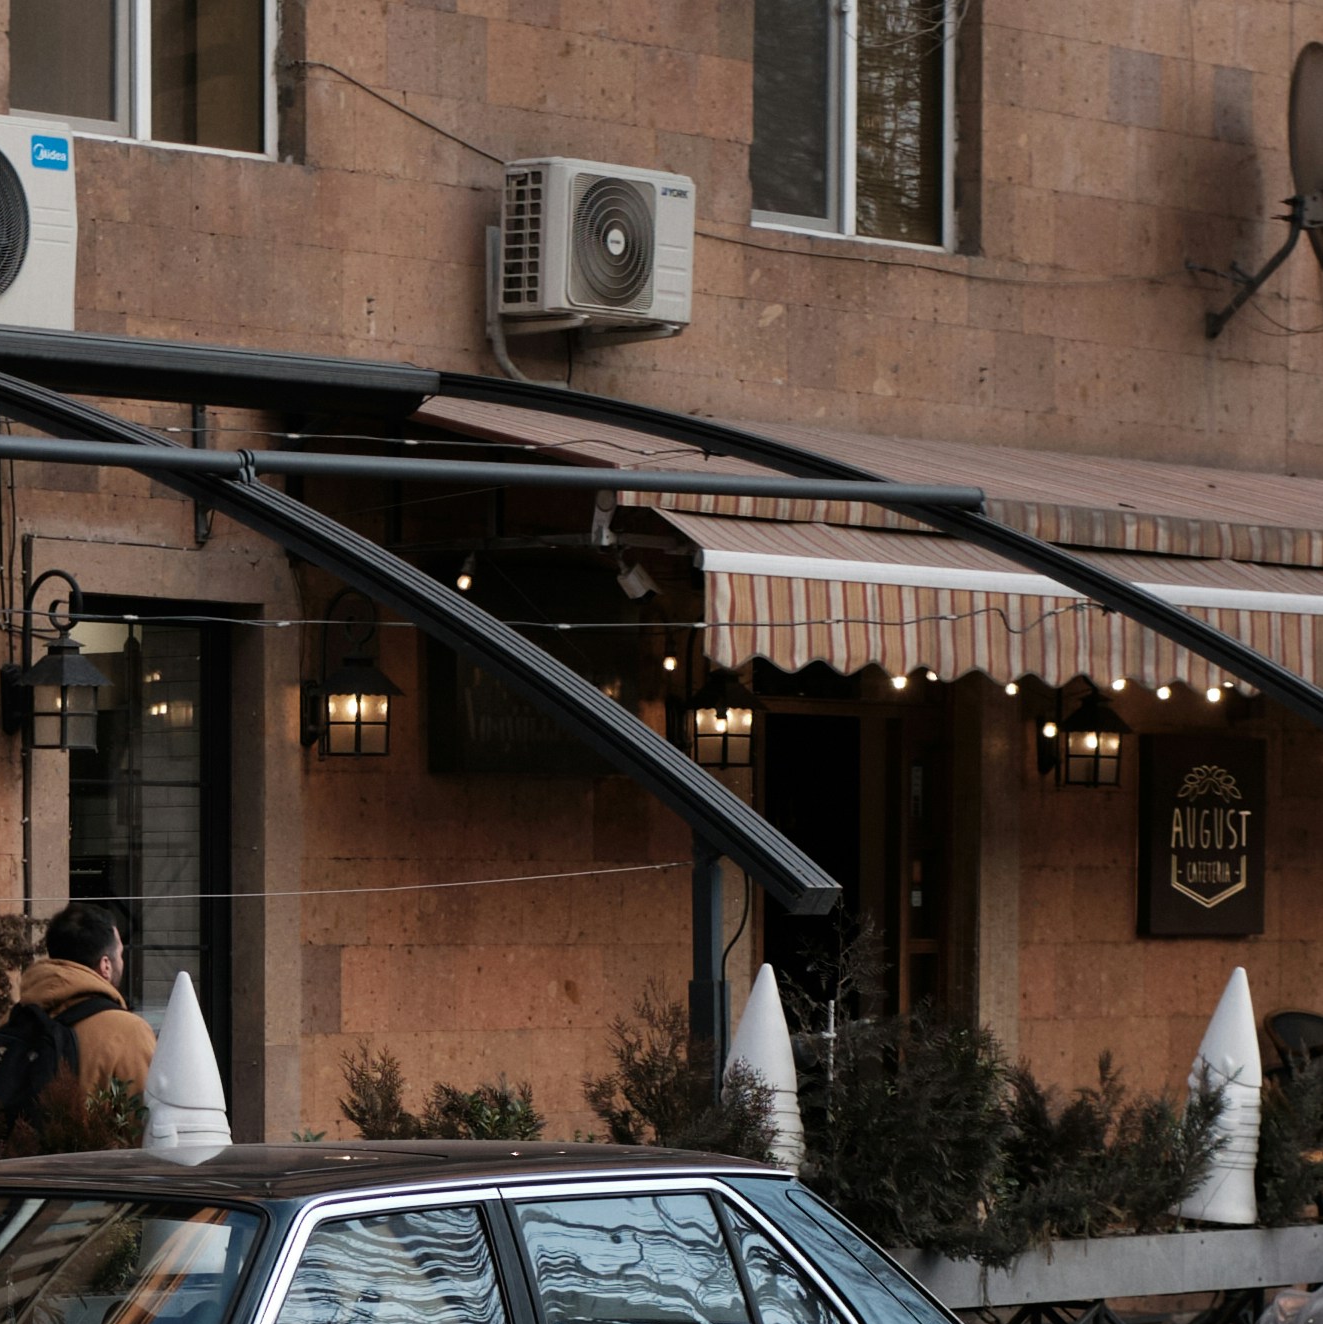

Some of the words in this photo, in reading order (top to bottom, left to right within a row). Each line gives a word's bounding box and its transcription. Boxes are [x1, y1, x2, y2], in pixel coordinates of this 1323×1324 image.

[669, 188, 689, 199] YORK
[1170, 806, 1252, 849] AUGUST
[1186, 861, 1230, 883] CAFETERIA
